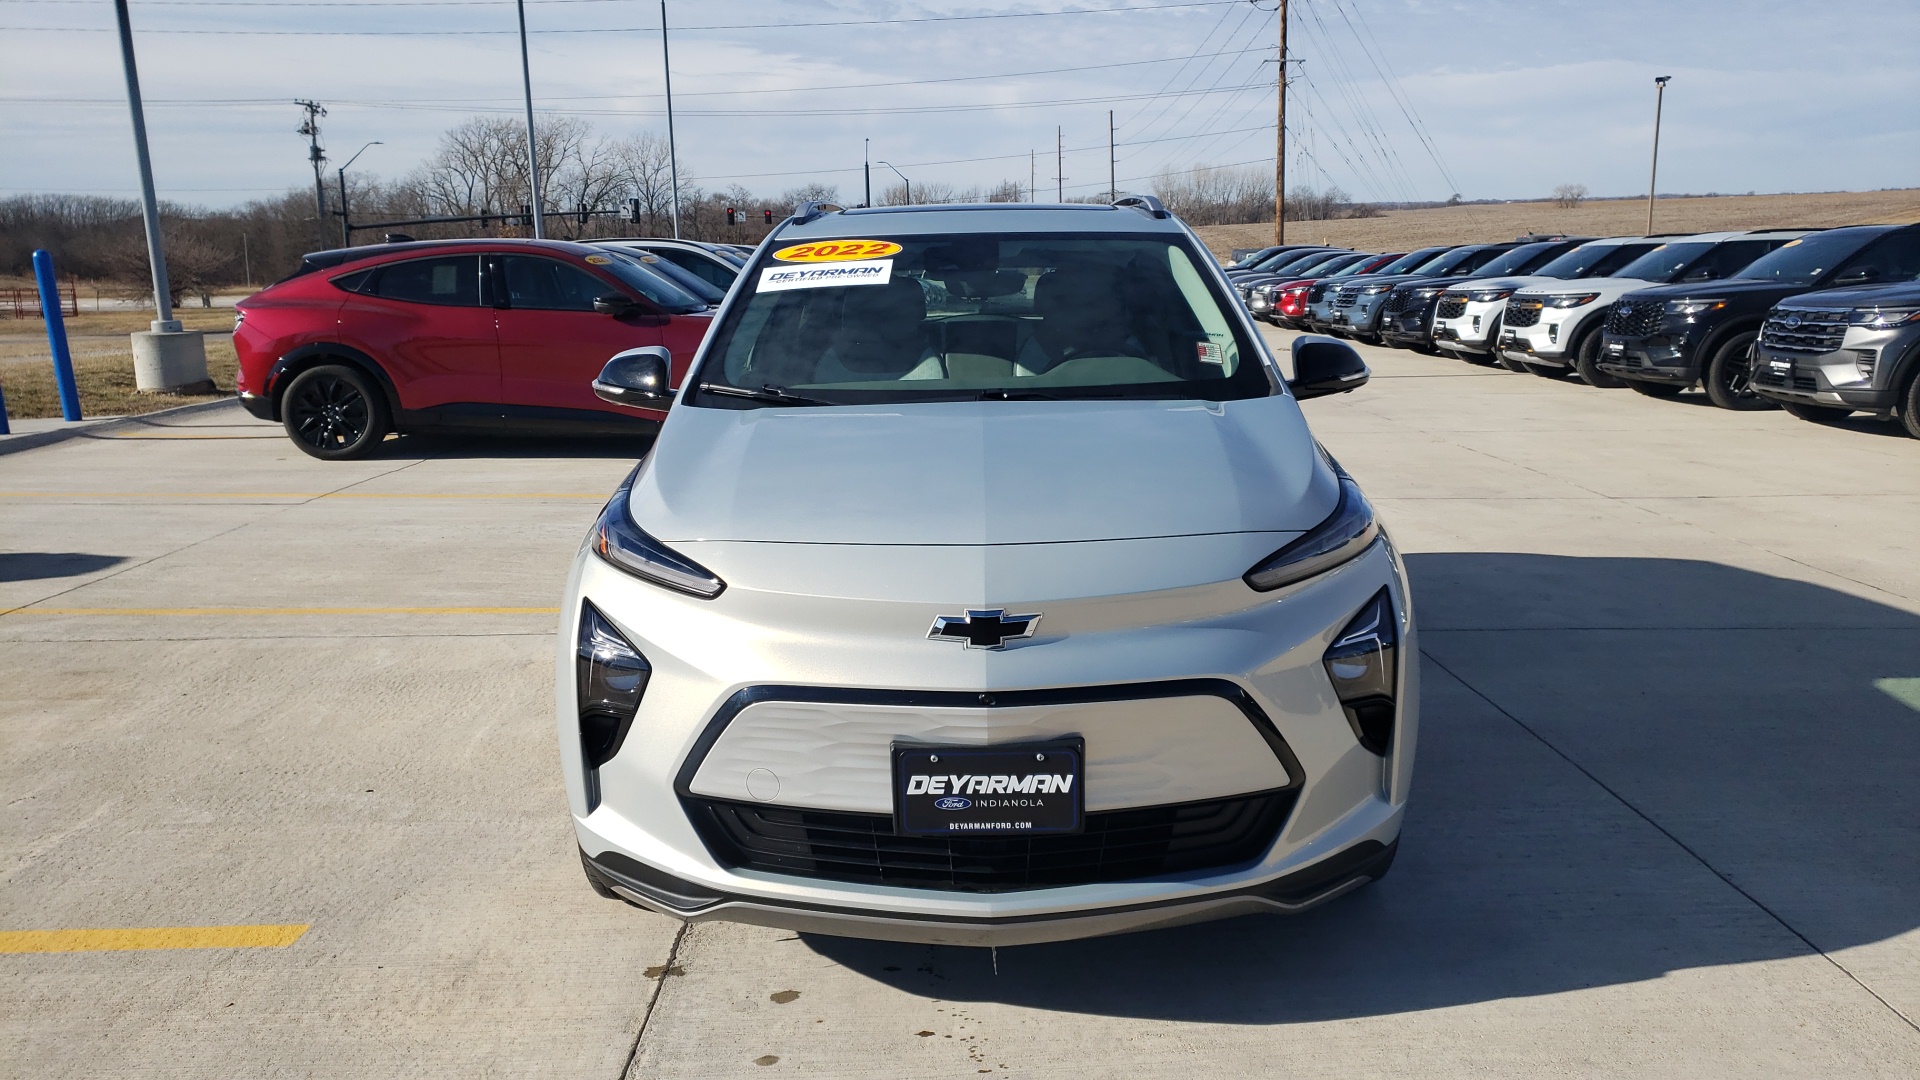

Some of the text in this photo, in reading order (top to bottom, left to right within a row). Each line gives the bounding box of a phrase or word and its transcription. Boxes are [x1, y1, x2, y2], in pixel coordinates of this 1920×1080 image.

[786, 243, 891, 259] 2022
[768, 266, 884, 281] DEYARMAN
[775, 276, 823, 284] CERTIFIED
[906, 774, 1073, 795] DEYARMAN
[942, 799, 1044, 808] Ford INDIANOLA
[949, 822, 1032, 830] DEYARMANFORD.COM
